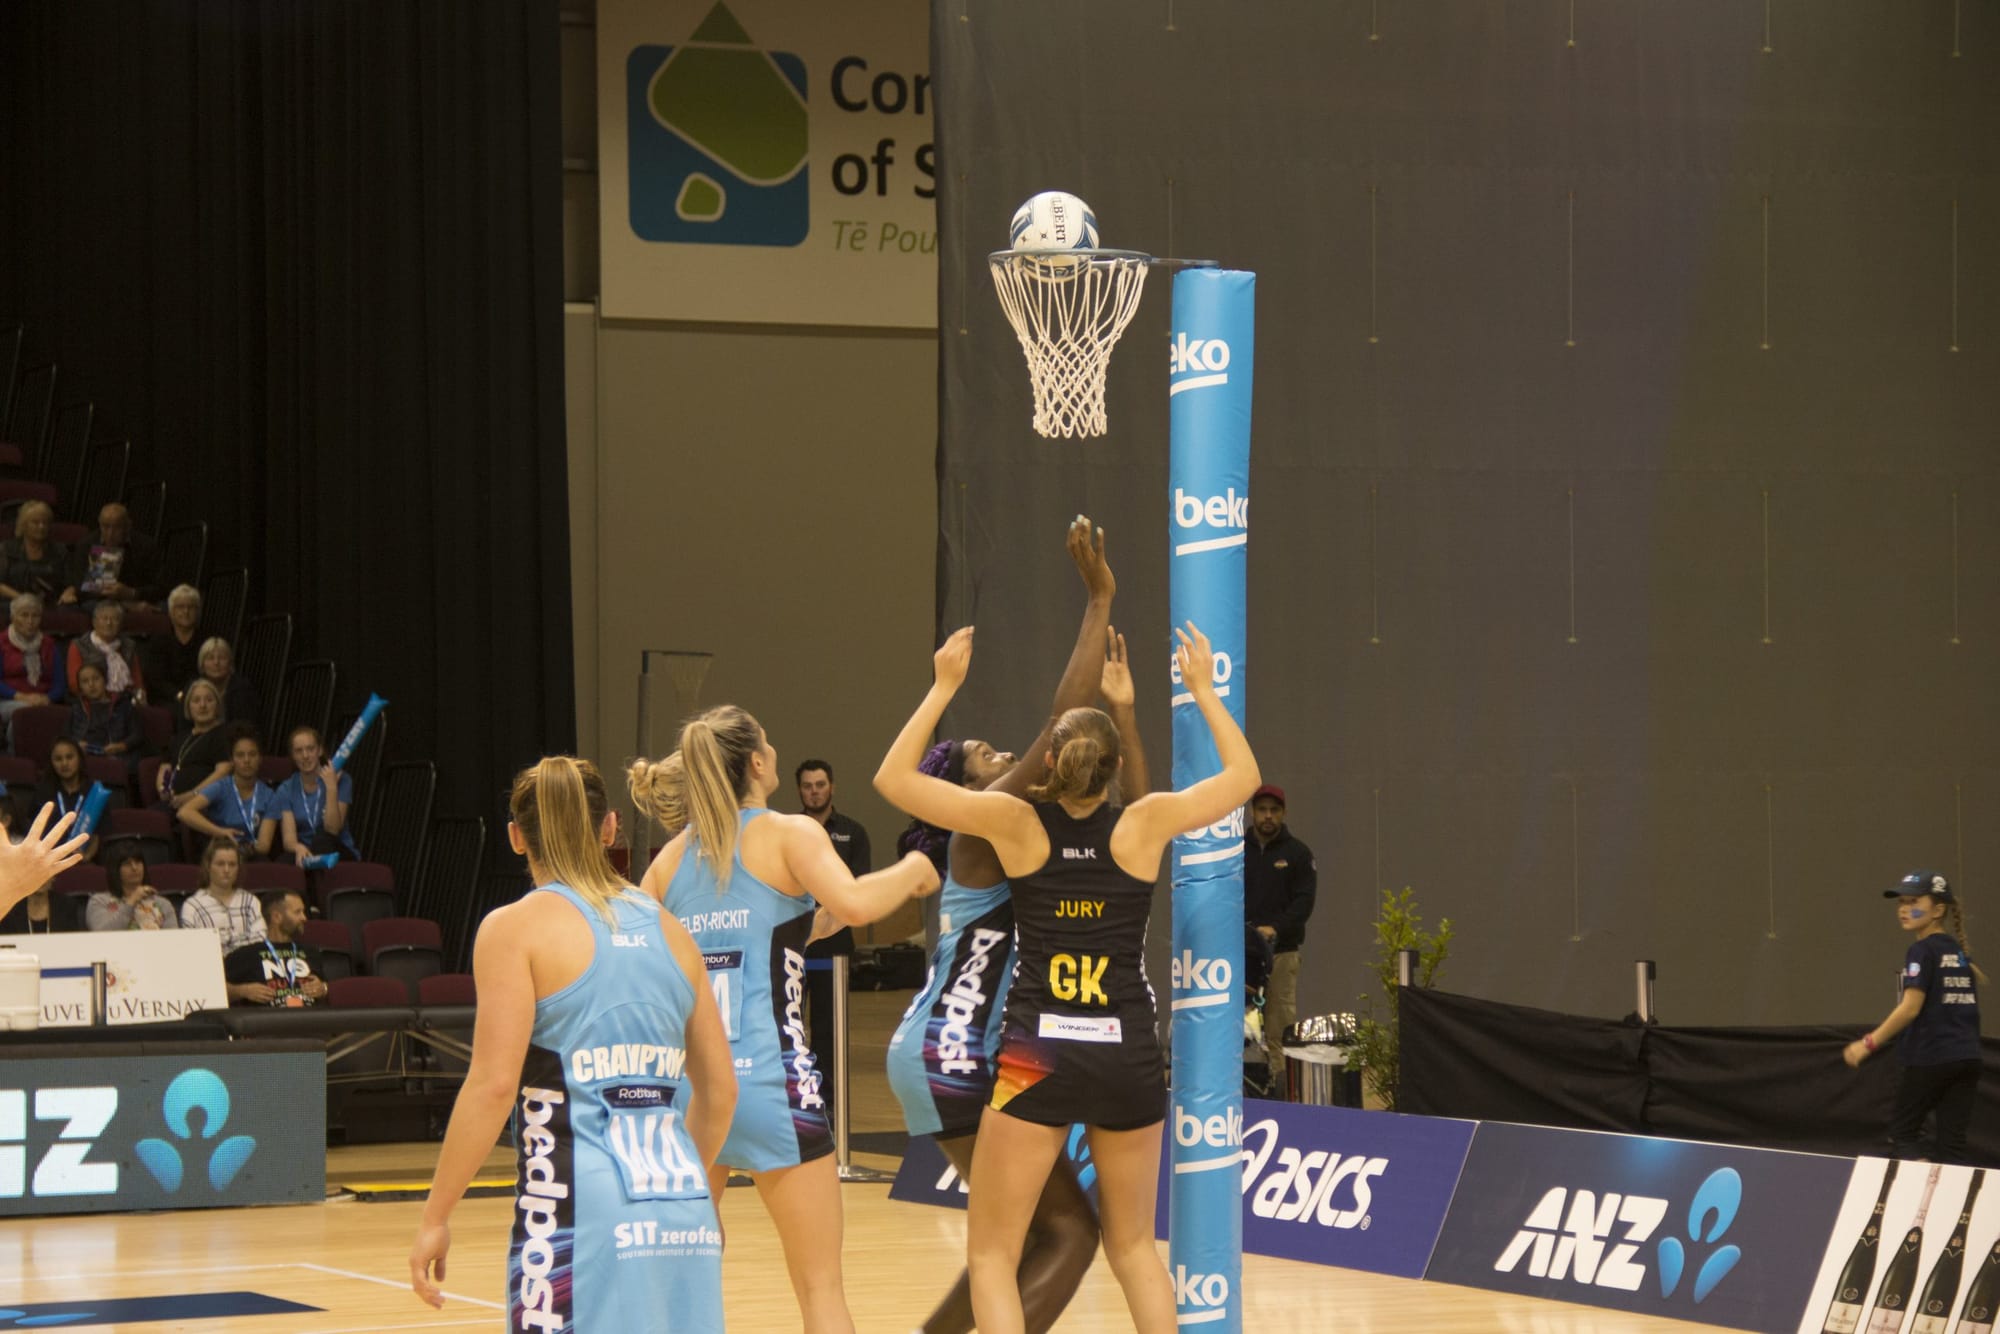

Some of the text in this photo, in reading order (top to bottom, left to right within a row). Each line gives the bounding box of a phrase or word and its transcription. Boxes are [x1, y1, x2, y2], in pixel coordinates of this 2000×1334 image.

[831, 139, 895, 196] of
[1170, 332, 1230, 375] eko
[1175, 488, 1248, 528] bek
[1062, 848, 1096, 859] BLK
[680, 909, 749, 934] ELBY-RICKIT
[1055, 901, 1105, 918] JURY
[611, 934, 649, 948] BLK
[1049, 953, 1110, 1006] GK
[1171, 949, 1232, 991] eko
[39, 1003, 86, 1022] UVE
[1175, 1106, 1242, 1148] bek
[519, 1086, 568, 1334] bedpost
[614, 1220, 721, 1248] SIT zerofee
[1494, 1186, 1670, 1292] ANZ
